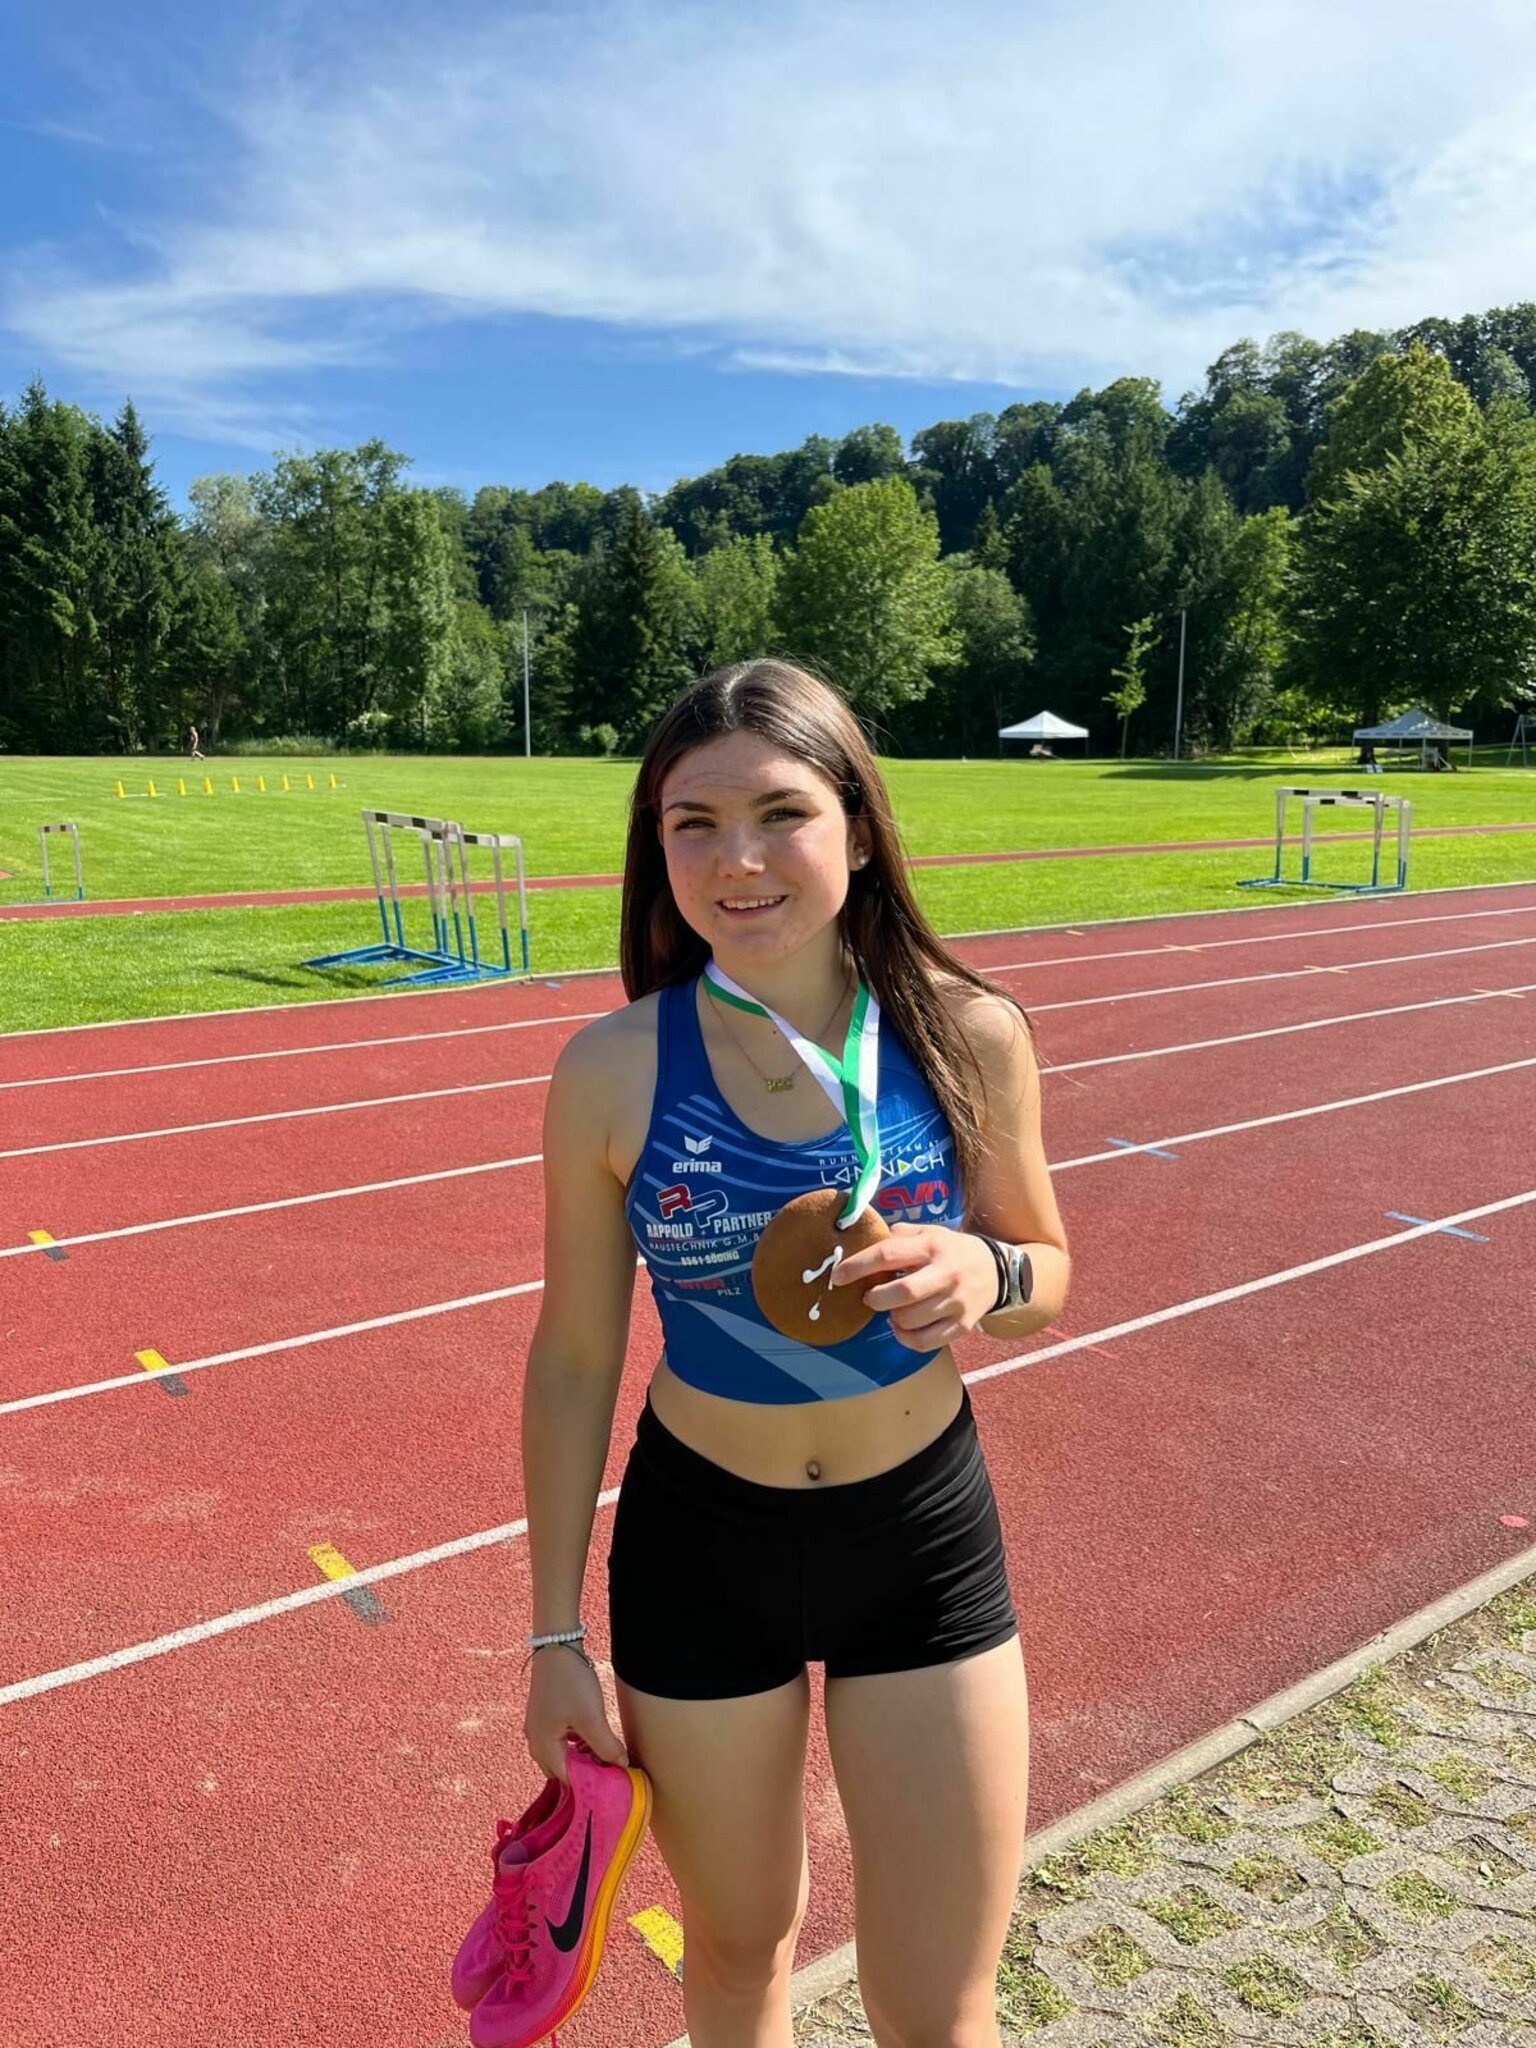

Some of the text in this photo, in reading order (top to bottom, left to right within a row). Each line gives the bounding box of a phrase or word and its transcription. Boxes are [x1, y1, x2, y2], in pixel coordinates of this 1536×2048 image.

[672, 1158, 722, 1173] erima
[646, 1223, 693, 1238] RAPPOLD
[714, 1211, 772, 1234] PARTNER
[649, 1240, 718, 1252] HAUSTECHNIK
[717, 1287, 741, 1297] PILZ
